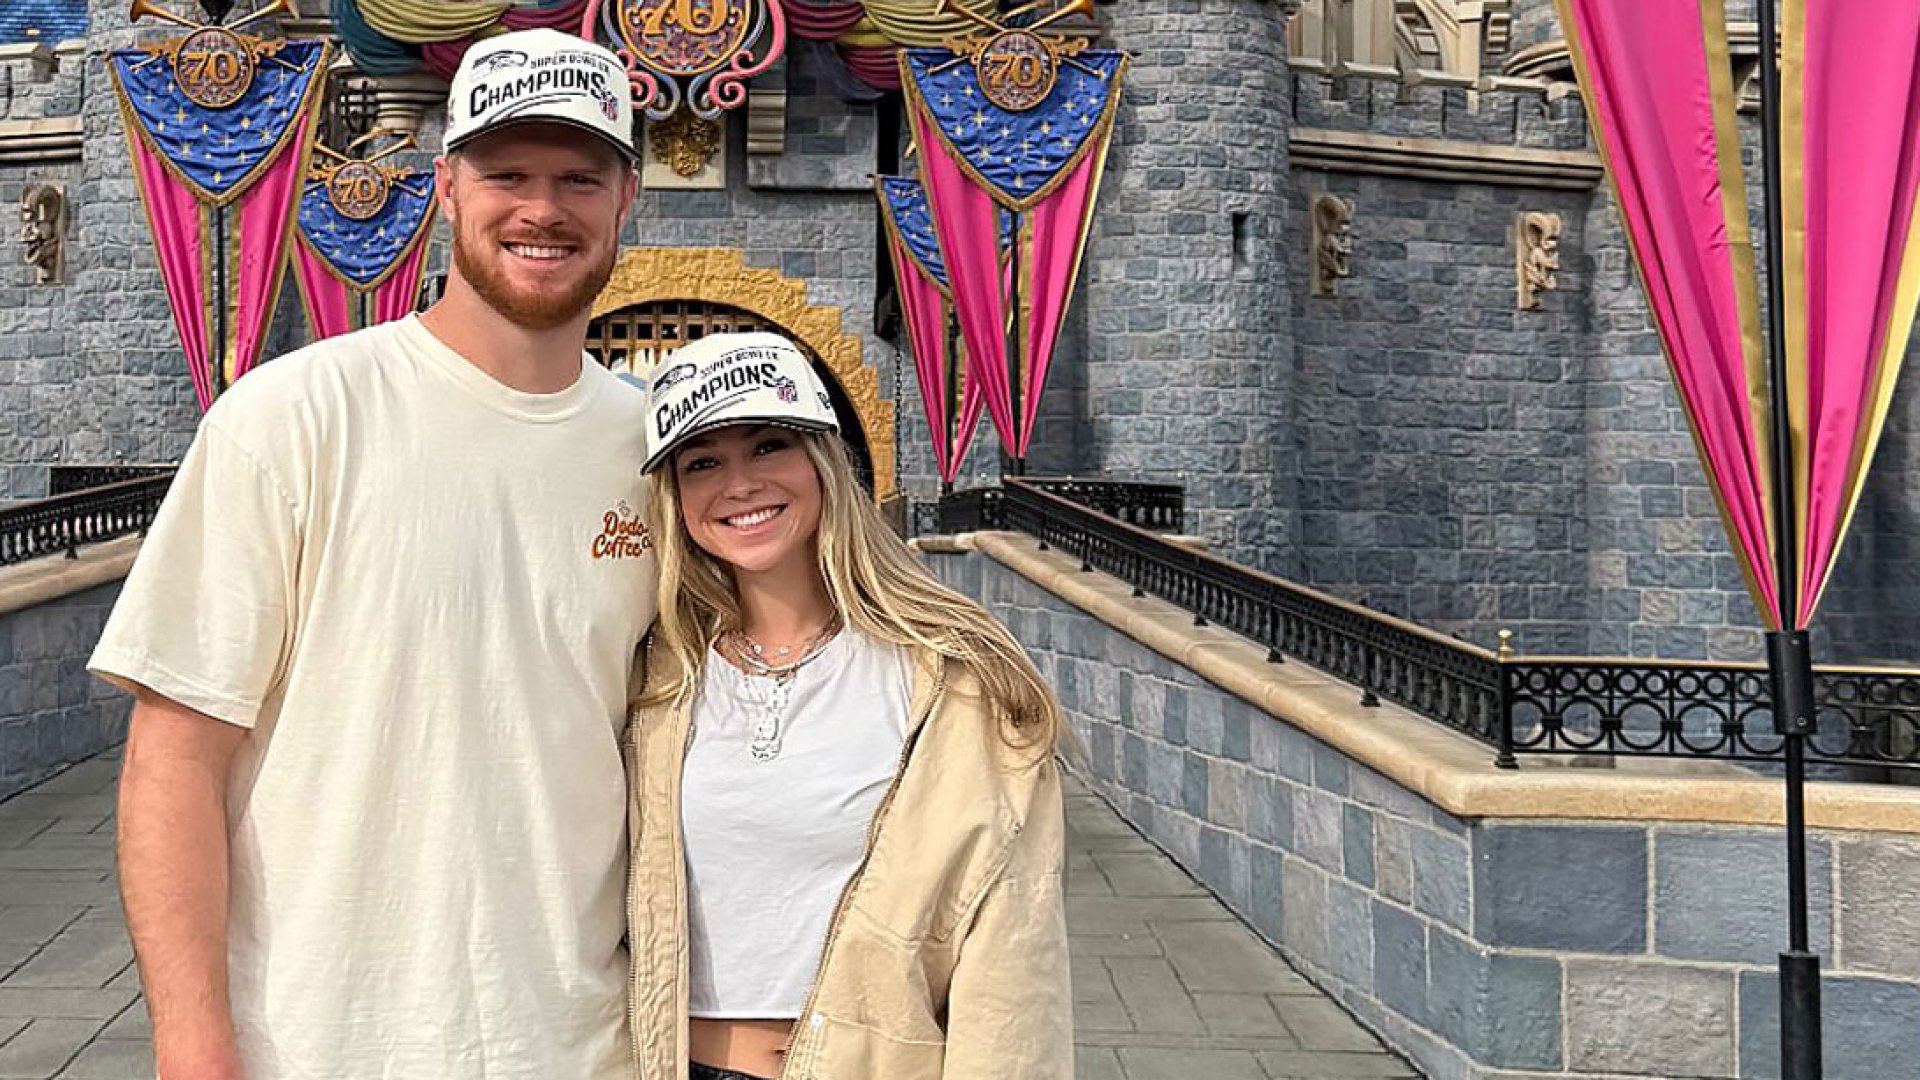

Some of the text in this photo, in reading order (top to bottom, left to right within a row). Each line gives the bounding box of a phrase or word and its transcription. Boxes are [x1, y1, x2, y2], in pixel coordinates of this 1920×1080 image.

[186, 51, 237, 84] 70
[531, 55, 566, 69] SUPER
[989, 54, 1043, 88] 70
[470, 68, 609, 118] CHAMPIONS
[338, 177, 377, 203] 70
[656, 363, 779, 440] CHAMPIONS
[591, 534, 643, 559] Coffee
